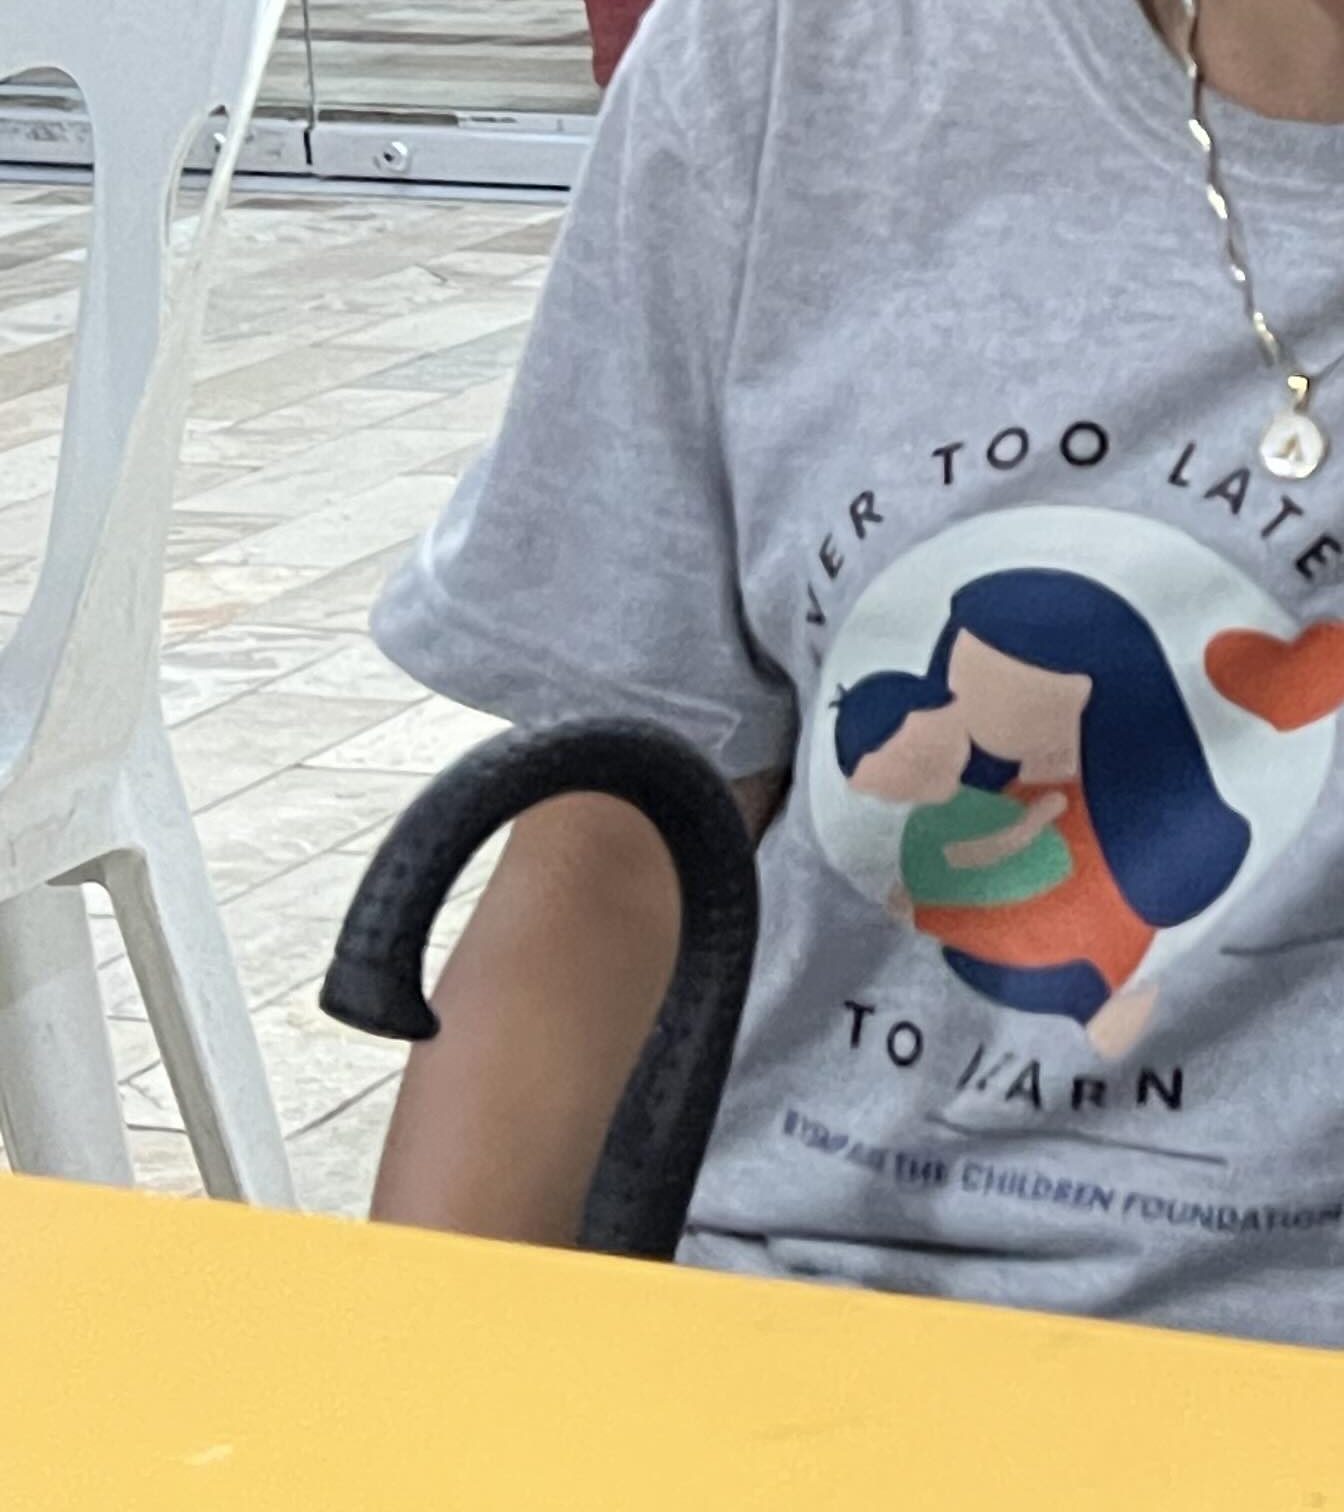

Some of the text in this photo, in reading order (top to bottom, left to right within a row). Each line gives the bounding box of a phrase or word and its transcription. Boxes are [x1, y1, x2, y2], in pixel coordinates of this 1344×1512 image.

[804, 420, 1343, 638] VER TOO LATE
[843, 1001, 923, 1068] TO
[961, 1159, 1115, 1213] CHILDREN
